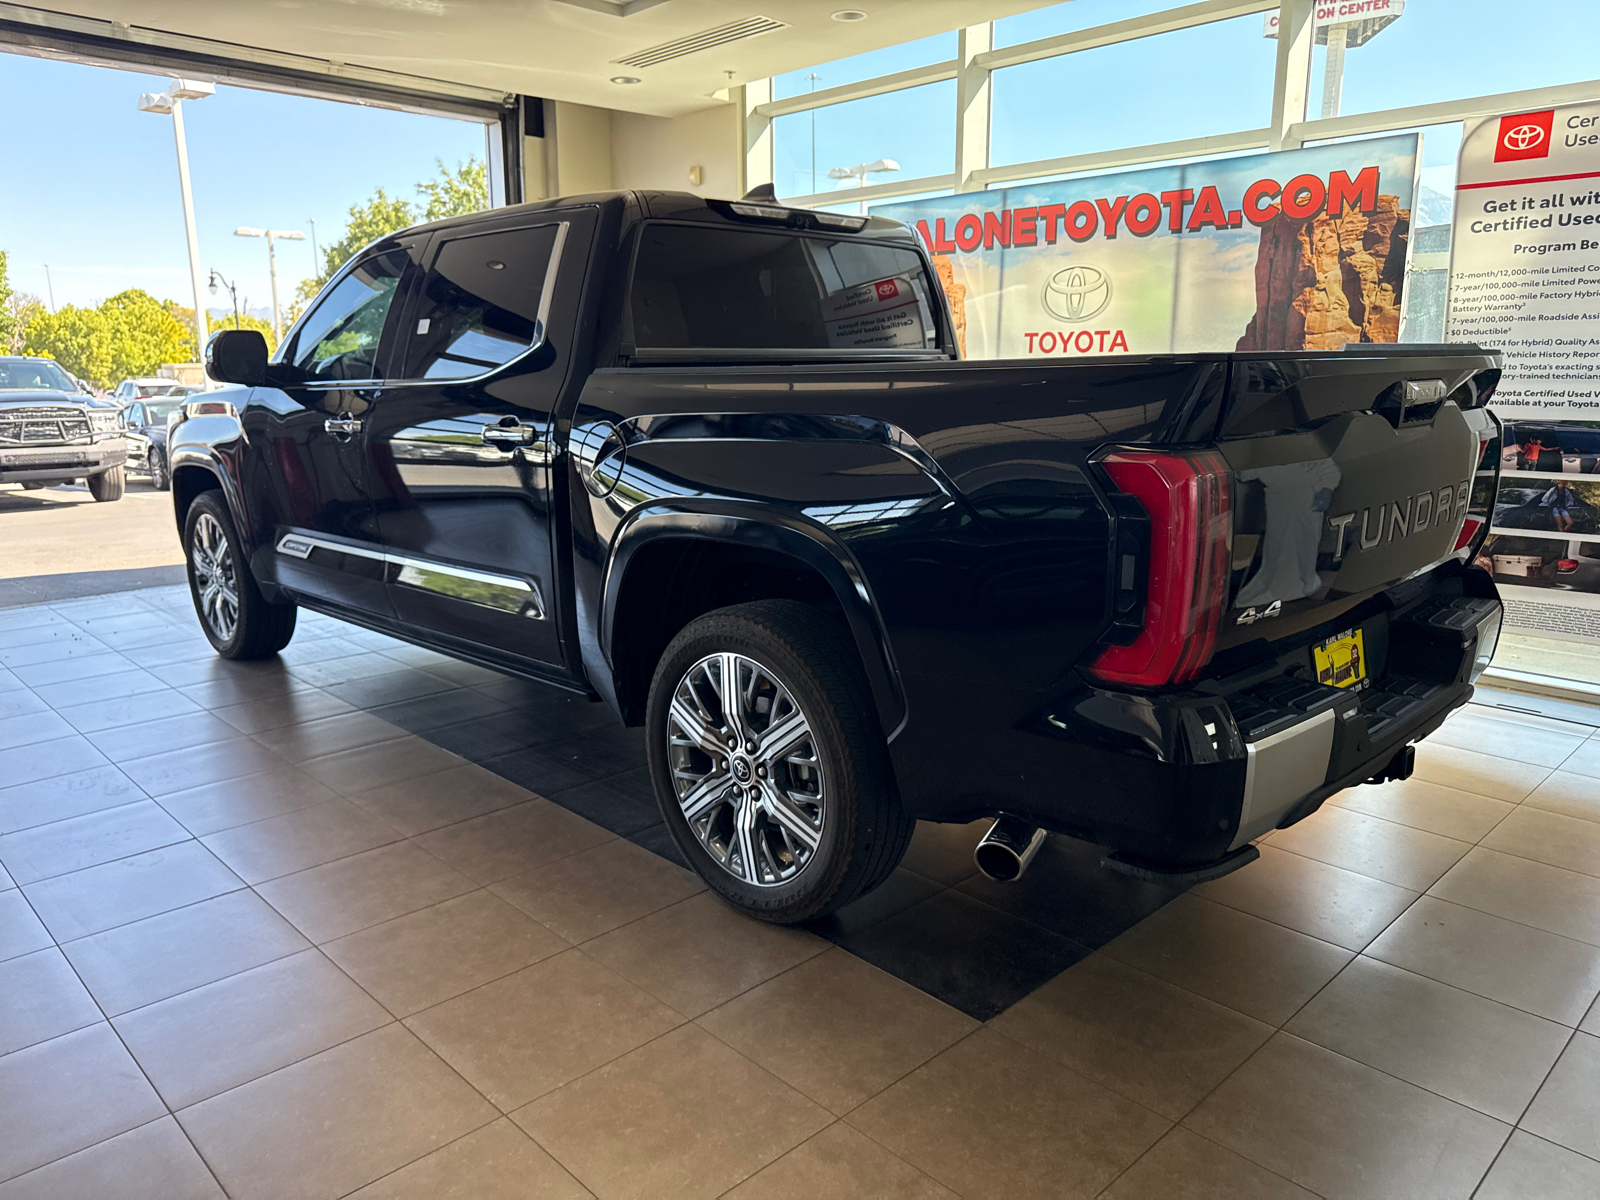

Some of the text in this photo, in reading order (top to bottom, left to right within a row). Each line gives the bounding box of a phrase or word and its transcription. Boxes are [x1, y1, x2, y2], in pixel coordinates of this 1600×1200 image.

[1339, 0, 1390, 15] CENTER
[1565, 132, 1600, 147] Use
[1483, 199, 1517, 214] Get
[1521, 197, 1535, 210] it
[1540, 193, 1565, 208] all
[1470, 214, 1553, 233] Certified
[1513, 241, 1576, 255] Program
[1455, 267, 1550, 280] 12-month/12,000-mile
[1552, 265, 1586, 274] Limited
[1454, 280, 1540, 292] 7-year/100,000-mile
[1542, 278, 1576, 287] Limited
[1540, 291, 1573, 300] Factory
[1575, 290, 1600, 299] Hybri
[1452, 305, 1483, 313] Battery
[1452, 314, 1537, 325] 7-year/100,000-mile
[1538, 313, 1580, 322] Roadside
[1450, 329, 1461, 337] $0
[1024, 329, 1130, 354] TOYOTA
[1489, 339, 1507, 347] (174
[1521, 339, 1553, 348] Hybrid)
[1555, 338, 1587, 347] Quality
[1539, 351, 1571, 360] History
[1555, 363, 1594, 372] exacting
[1501, 372, 1551, 381] ory-trained
[1524, 389, 1565, 397] Certified
[1543, 401, 1566, 409] your
[1567, 401, 1600, 409] Toyota
[1327, 479, 1470, 563] TUNDRA
